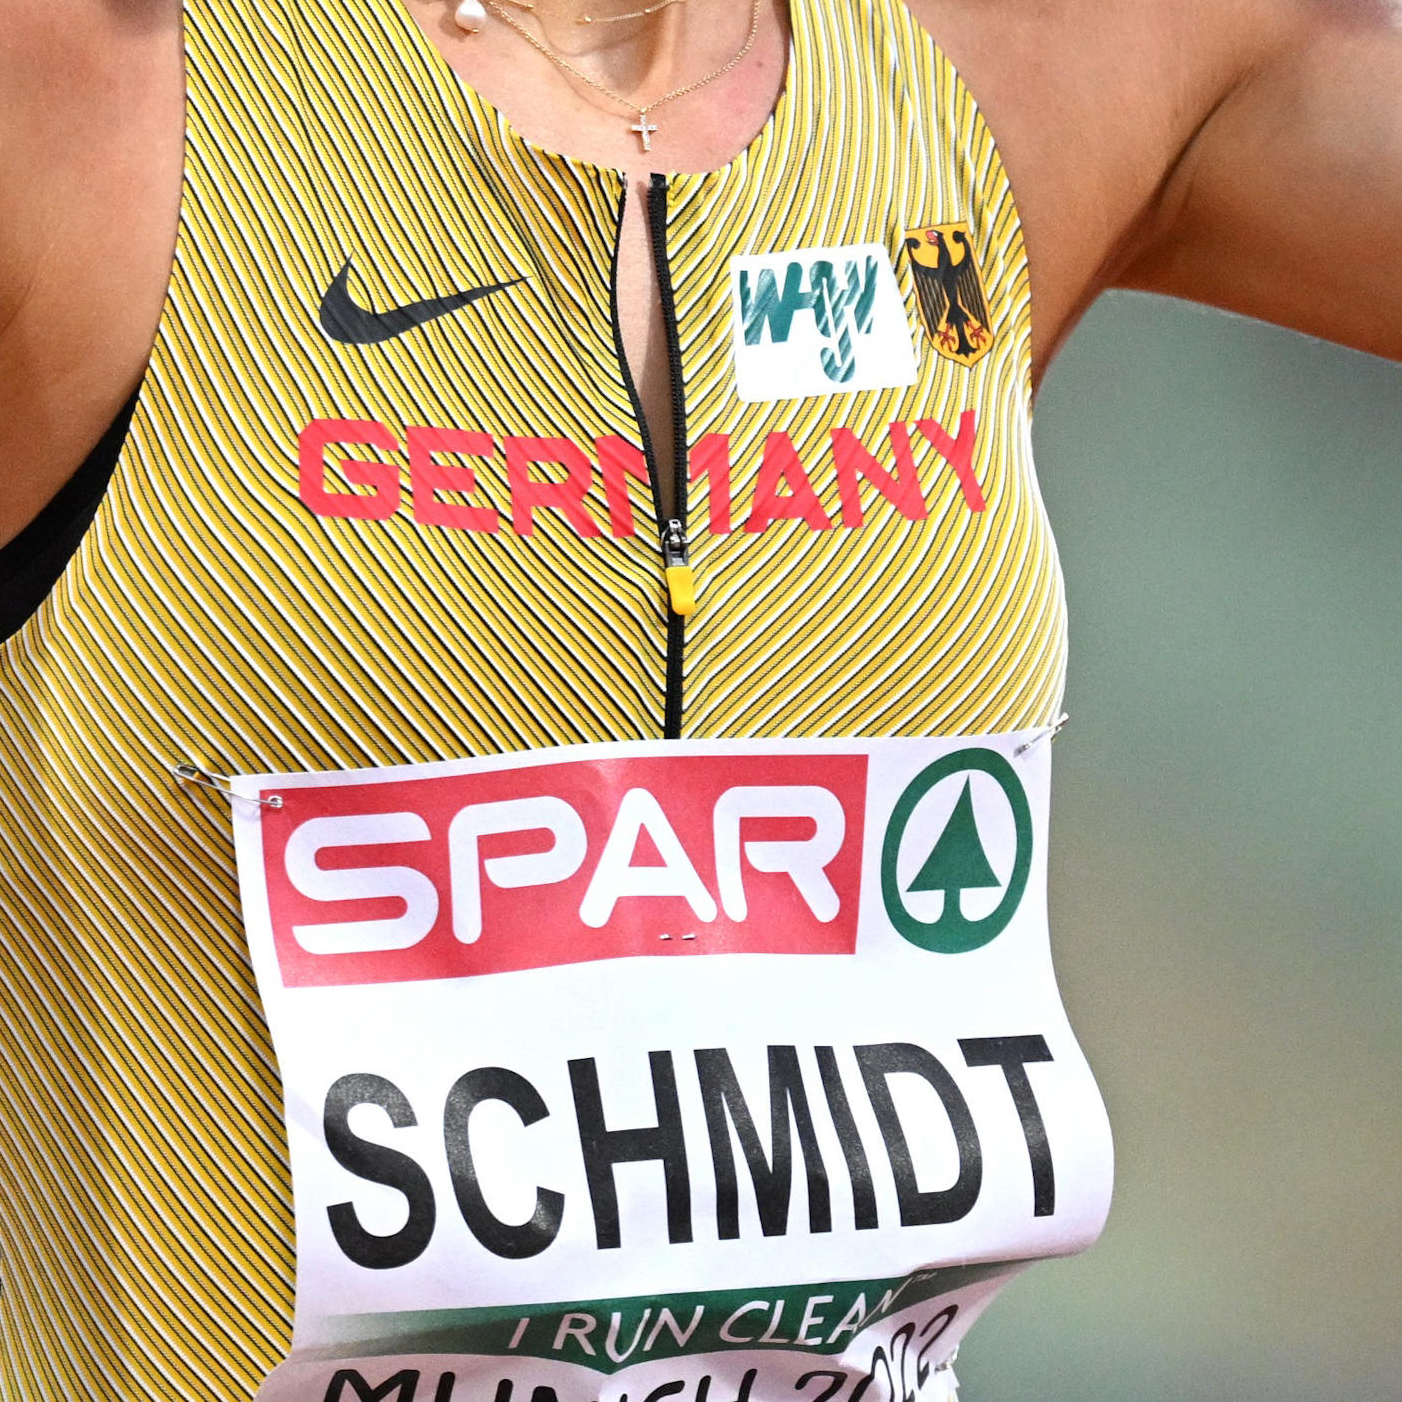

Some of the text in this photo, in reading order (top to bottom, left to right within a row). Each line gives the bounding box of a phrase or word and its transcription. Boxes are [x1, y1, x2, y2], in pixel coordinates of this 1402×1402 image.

[298, 409, 987, 538] GERMANY
[282, 784, 847, 955] SPAR
[322, 1034, 1057, 1271] SCHMIDT
[507, 1276, 914, 1364] I RUN CLEAN
